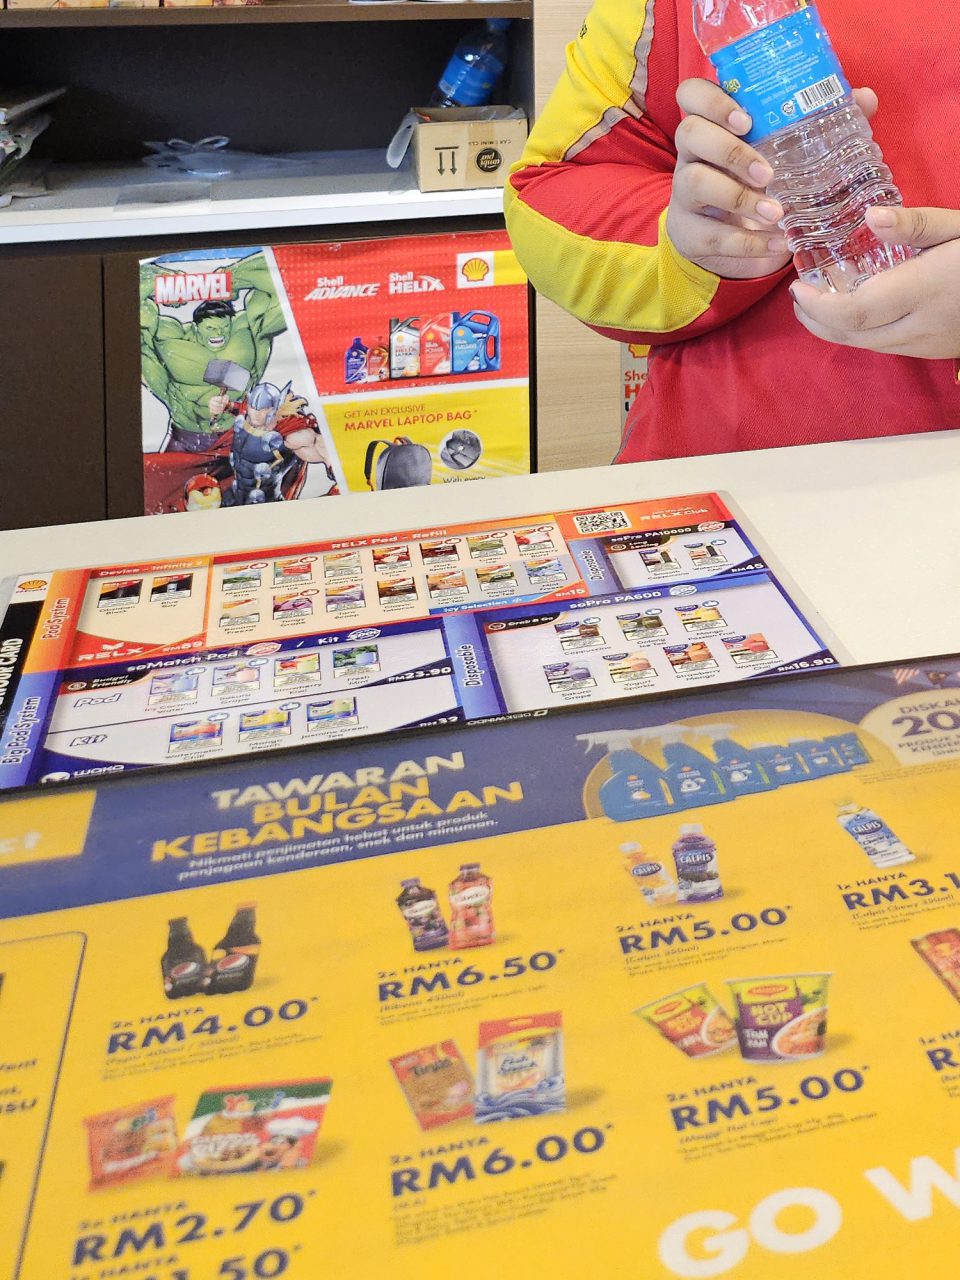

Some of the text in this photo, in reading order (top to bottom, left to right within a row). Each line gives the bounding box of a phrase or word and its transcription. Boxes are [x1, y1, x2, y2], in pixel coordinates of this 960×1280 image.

[317, 276, 344, 287] Shell
[389, 272, 414, 282] Shell
[389, 275, 446, 294] HELIX
[155, 272, 231, 303] MARVEL
[304, 282, 380, 301] ADVANCE
[344, 404, 426, 420] GET AN EXCLUSIVE
[344, 410, 473, 432] MARVEL LAPTOP BAG
[331, 530, 447, 550] RELX Pod Refill
[611, 535, 642, 543] soPro
[100, 567, 139, 577] Device
[582, 550, 605, 581] Disposable
[731, 562, 764, 573] RM45
[569, 591, 661, 609] soPro PA600
[78, 648, 143, 661] RELX
[127, 636, 339, 672] soMatch Pod Kit
[463, 645, 484, 687] Disposable
[777, 657, 834, 673] RM16.90
[387, 667, 451, 683] RM23.90
[74, 693, 122, 708] Pod
[14, 697, 41, 731] System
[898, 735, 950, 749] PRODUK
[2, 745, 29, 764] Big
[211, 751, 465, 810] TAWARAN
[253, 776, 431, 824] BULAN
[151, 781, 524, 862] KEBANGSAAN
[852, 821, 882, 834] CALPIS
[189, 811, 488, 869] Nikmati penjimatan hebat untuk produk
[178, 820, 499, 883] penjagaan kenderaan, snek dan minuman.
[679, 852, 712, 865] CALPIS
[632, 863, 662, 876] CALPIS
[856, 872, 908, 888] HANYA
[639, 912, 695, 928] HANYA
[403, 957, 463, 974] HANYA
[140, 1006, 205, 1024] HANYA
[751, 1002, 788, 1015] HOT
[756, 1014, 793, 1026] CUP
[692, 1076, 758, 1098] HANYA
[419, 1136, 490, 1159] HANYA
[657, 1184, 843, 1279] GO
